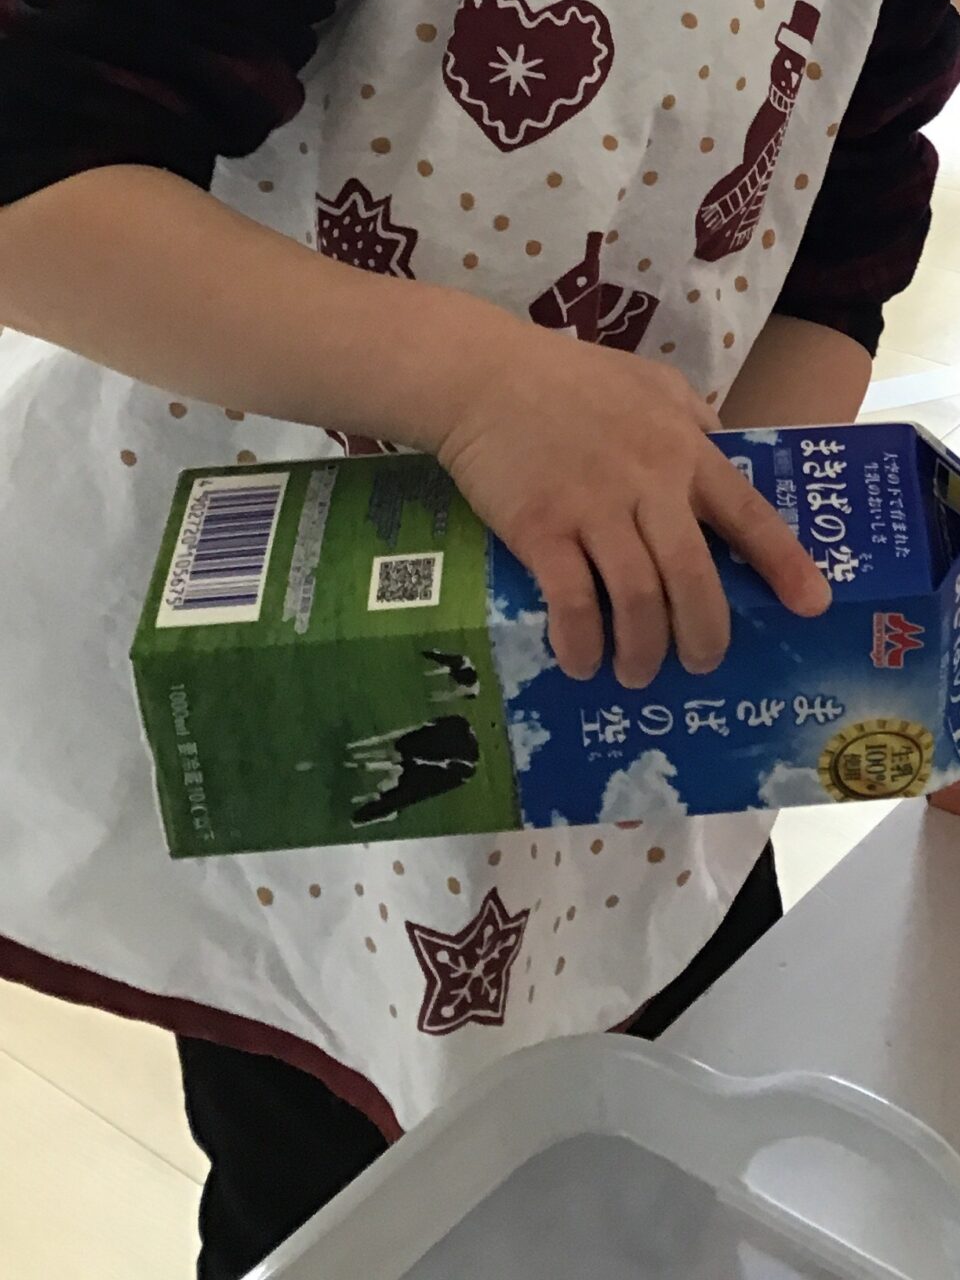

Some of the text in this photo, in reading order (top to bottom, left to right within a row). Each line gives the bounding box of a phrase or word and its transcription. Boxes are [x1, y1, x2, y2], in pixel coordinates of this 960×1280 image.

[799, 438, 860, 584] まきばの空
[864, 461, 888, 545] 生乳のおいしさ
[579, 694, 845, 749] まきばの空
[864, 742, 888, 792] 100%
[890, 745, 914, 782] 生乳
